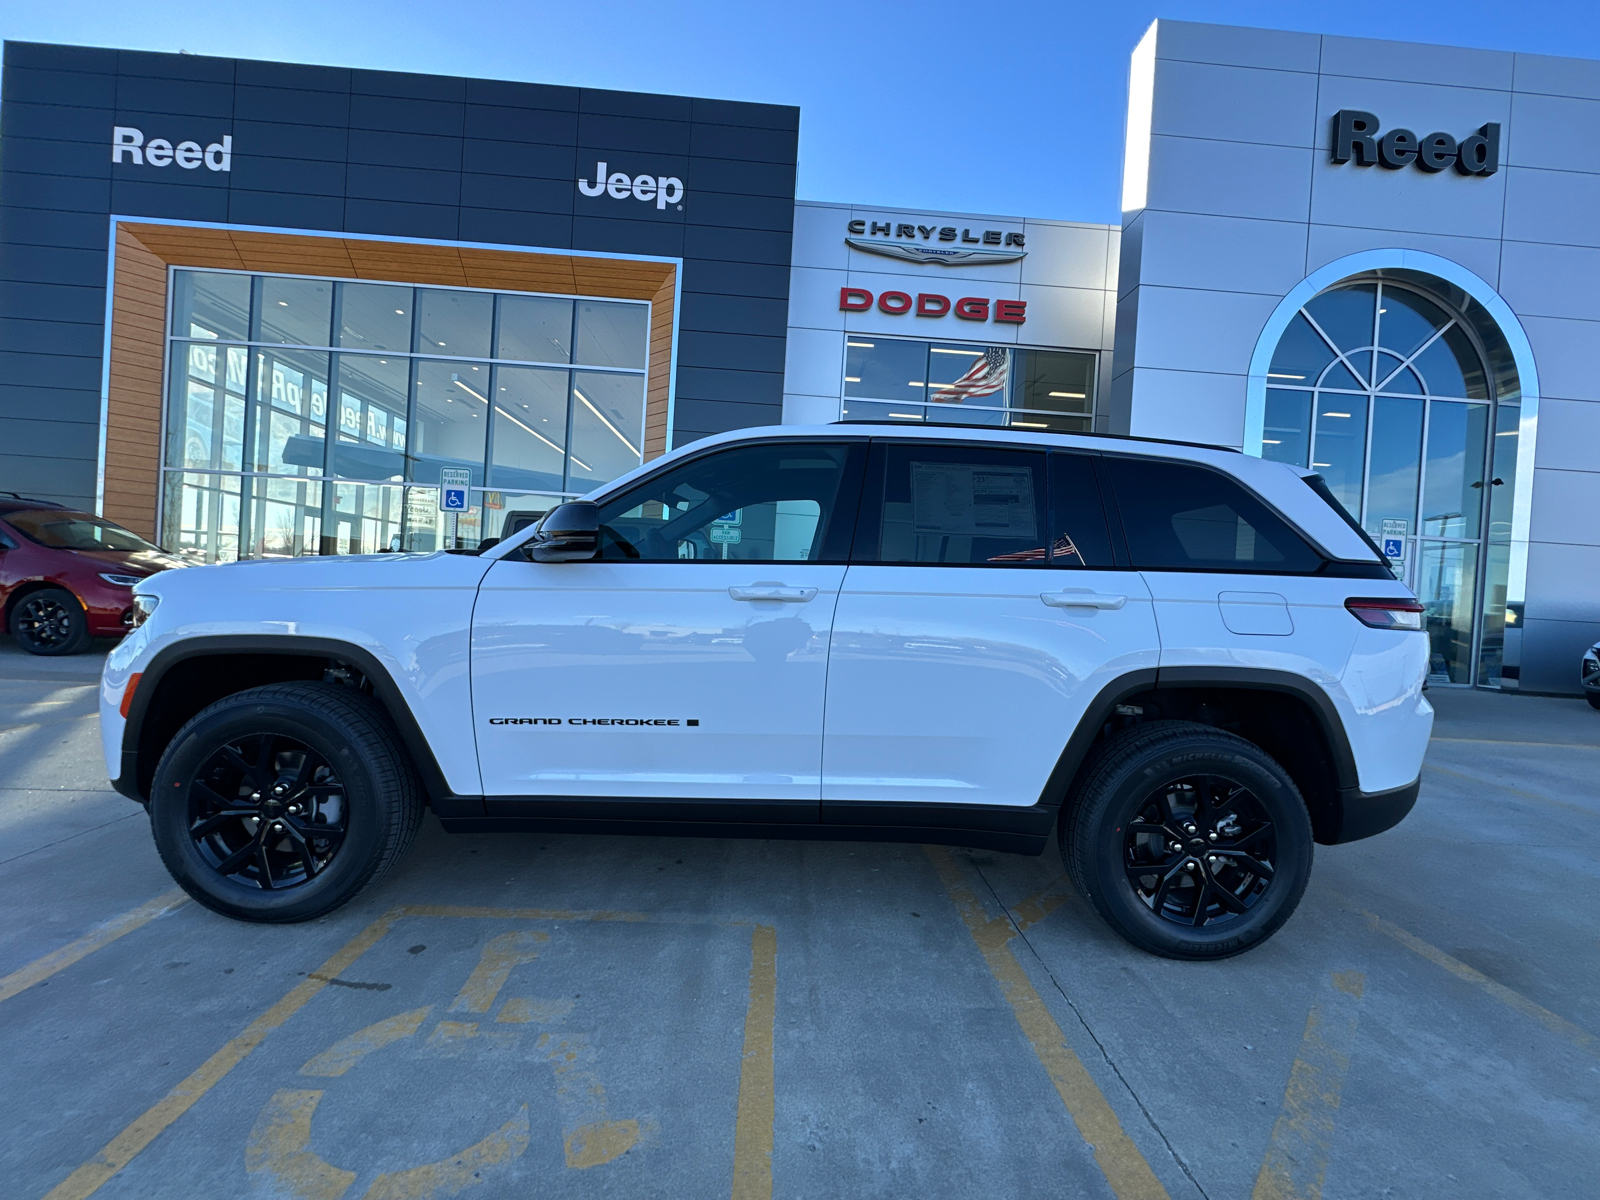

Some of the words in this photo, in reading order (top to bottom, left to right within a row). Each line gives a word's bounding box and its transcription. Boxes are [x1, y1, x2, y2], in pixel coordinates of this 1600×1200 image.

[112, 126, 232, 171] Reed
[1331, 109, 1501, 177] Reed
[578, 162, 684, 210] Jeep
[847, 219, 1026, 246] CHRYSLER
[839, 287, 1027, 324] DODGE
[443, 471, 469, 479] RESERVED
[1383, 521, 1406, 529] RESERVED
[568, 718, 680, 726] CHEROKEE
[1179, 939, 1238, 952] MICHELIN
